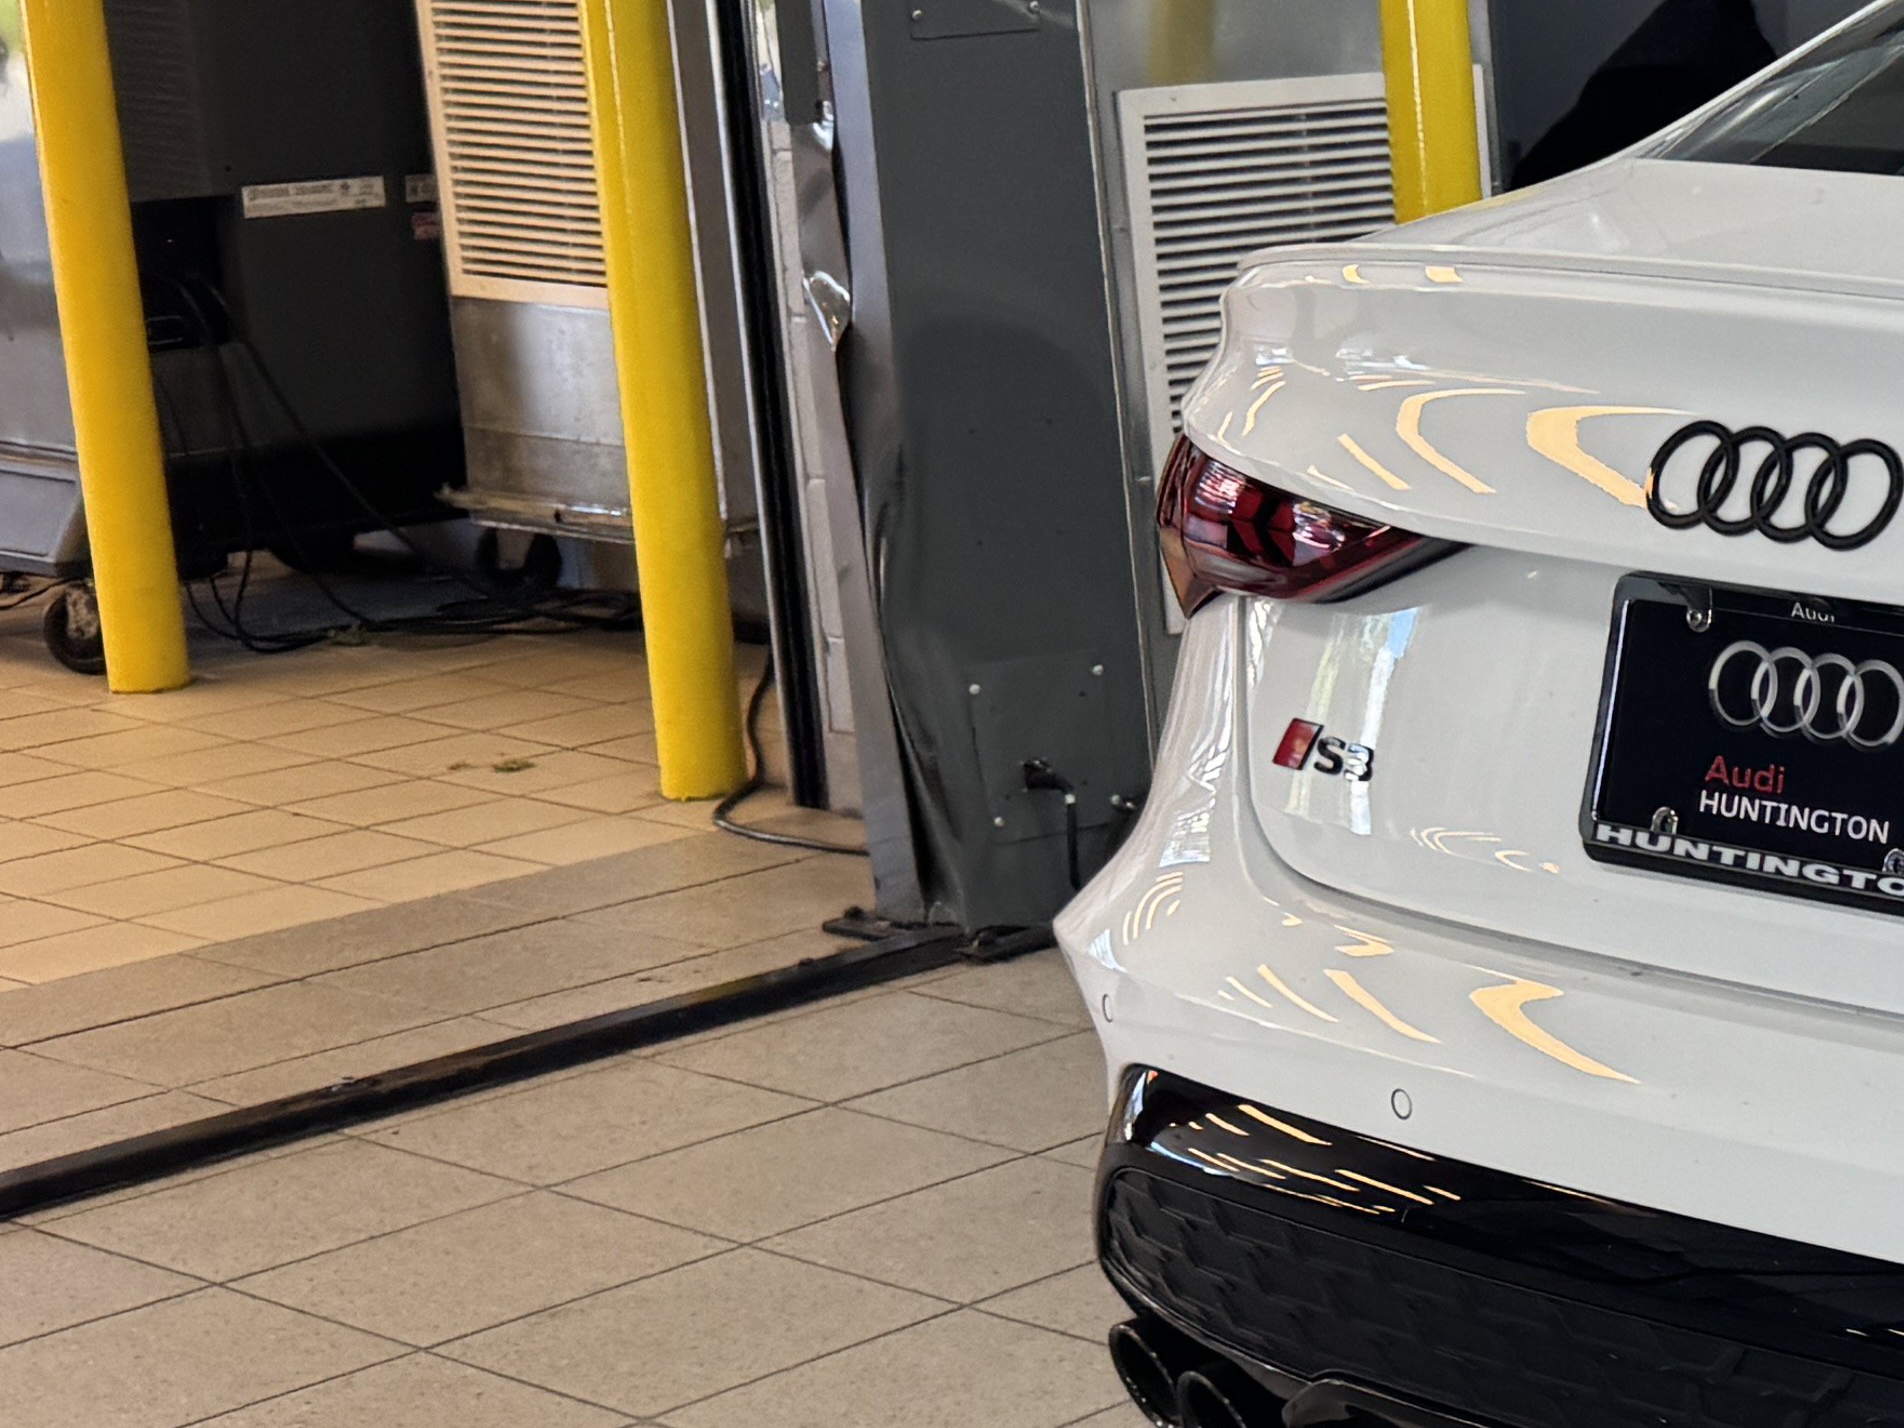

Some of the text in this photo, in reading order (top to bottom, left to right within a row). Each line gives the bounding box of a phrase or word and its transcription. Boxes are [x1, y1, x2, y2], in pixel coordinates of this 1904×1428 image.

[1313, 736, 1374, 781] S3
[1704, 754, 1786, 794] Audi
[1698, 788, 1891, 845] HUNTINGTON
